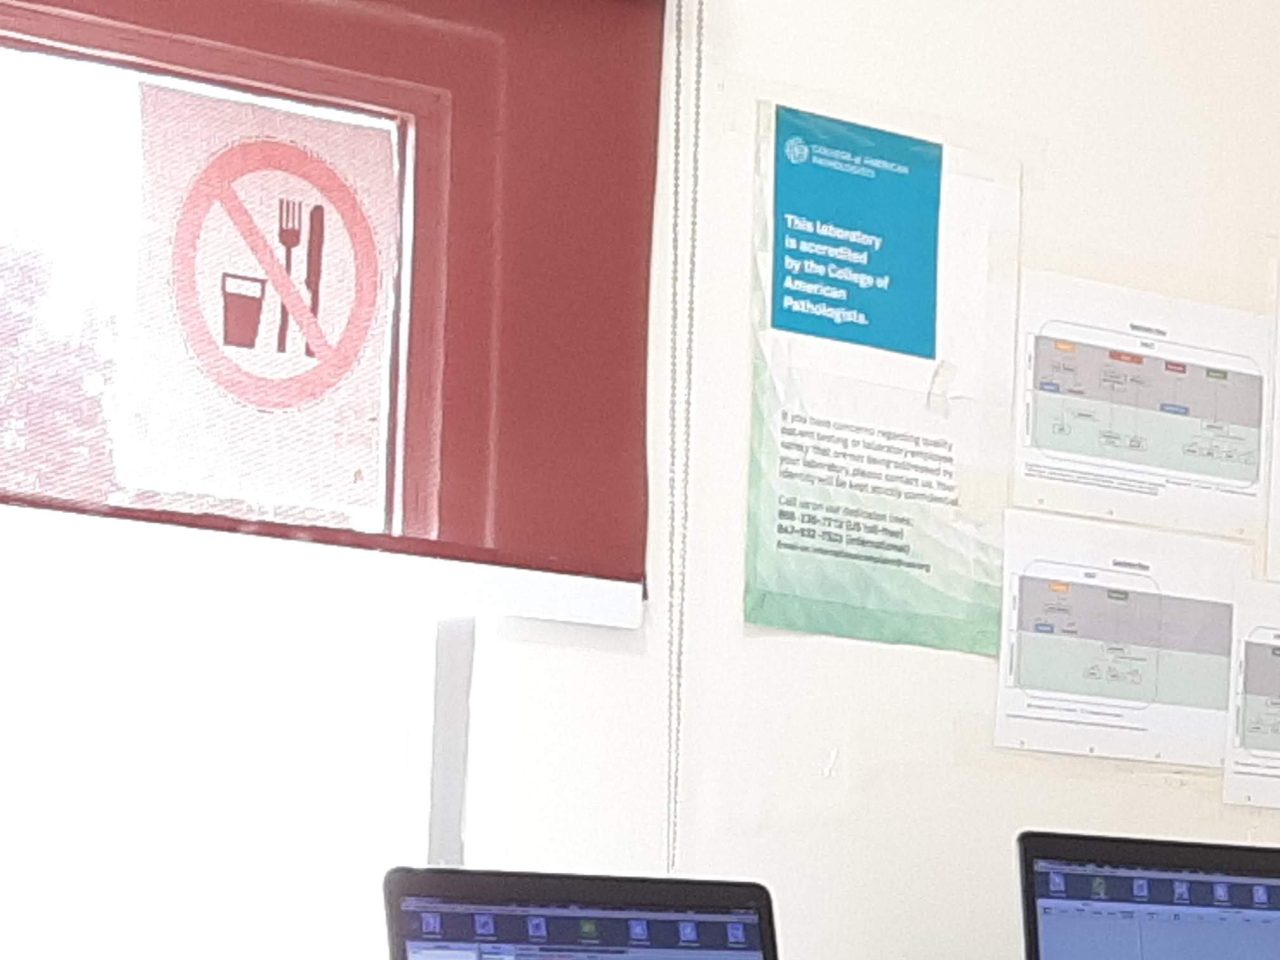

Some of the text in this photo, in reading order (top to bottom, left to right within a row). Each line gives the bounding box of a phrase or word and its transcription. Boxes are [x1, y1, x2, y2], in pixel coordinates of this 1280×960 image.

[784, 213, 883, 251] This laboratory
[784, 234, 868, 265] is accredited
[783, 275, 848, 300] American
[784, 254, 890, 290] by the College of
[783, 295, 870, 325] Pathologists.
